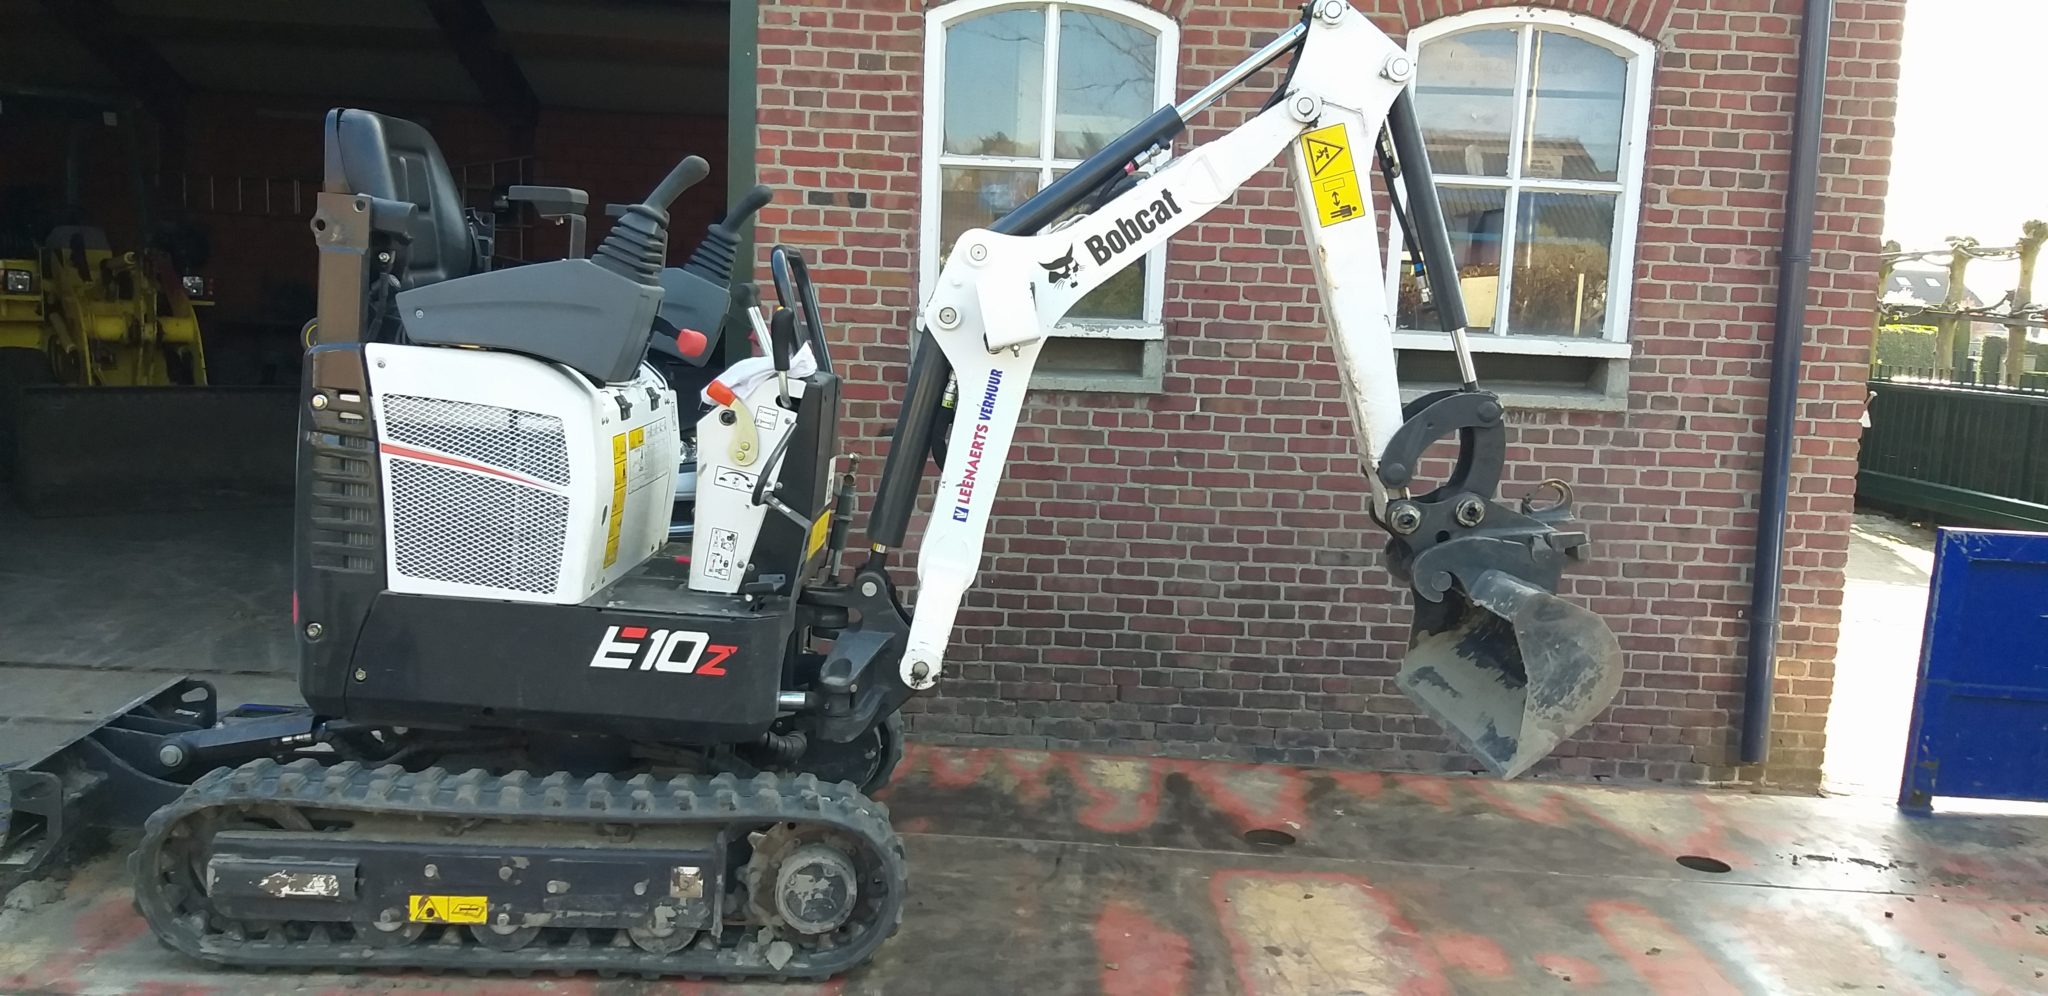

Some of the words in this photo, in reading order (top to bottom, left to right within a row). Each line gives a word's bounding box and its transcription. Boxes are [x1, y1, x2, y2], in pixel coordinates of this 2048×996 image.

[1084, 188, 1182, 266] Bobcat
[957, 424, 988, 504] LEENAERTS
[979, 368, 1003, 420] VERHUUR
